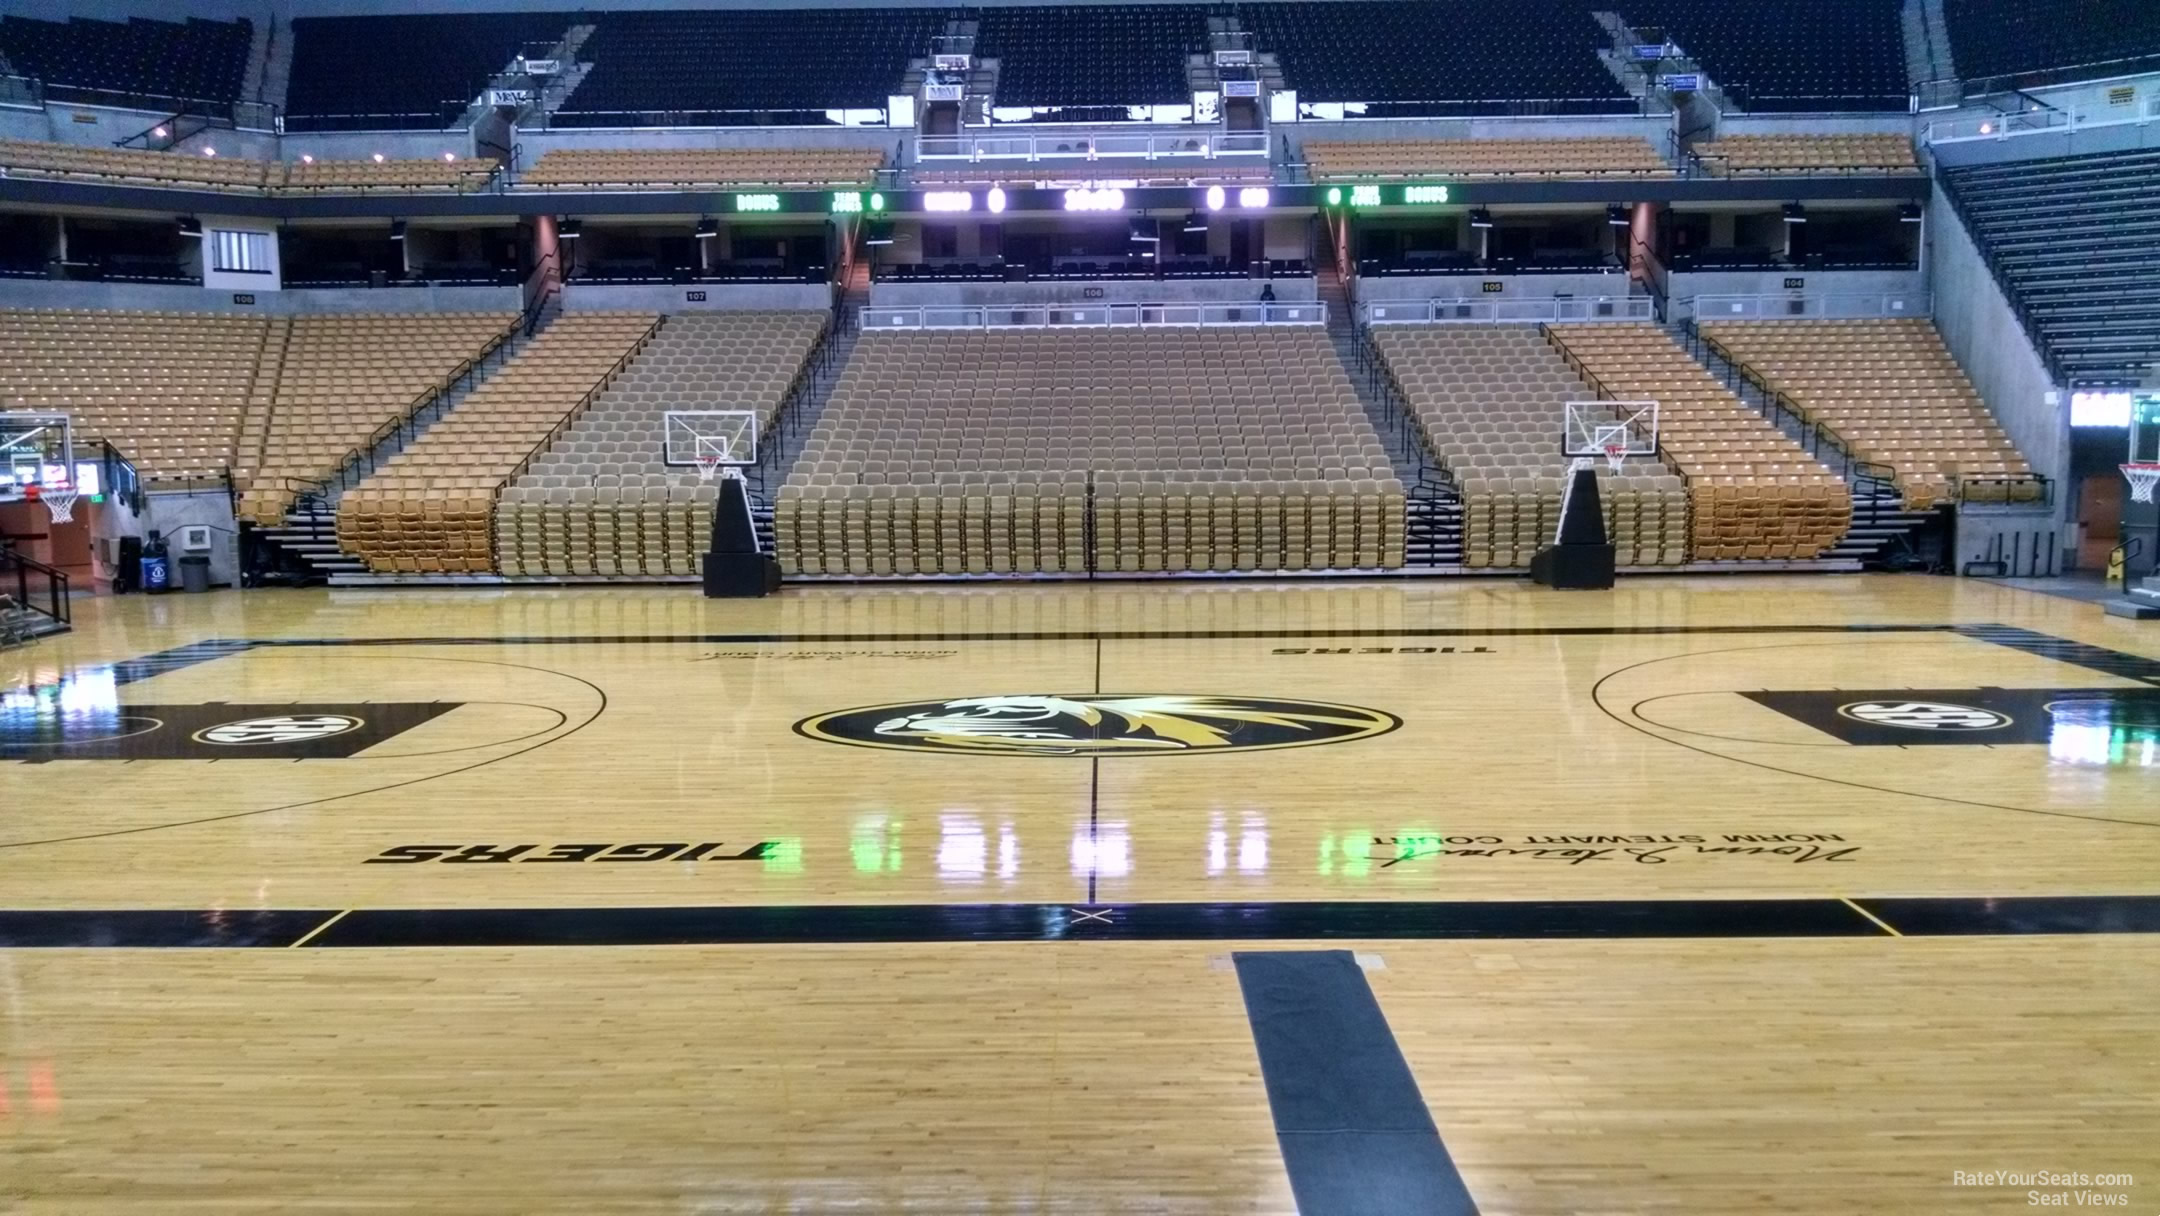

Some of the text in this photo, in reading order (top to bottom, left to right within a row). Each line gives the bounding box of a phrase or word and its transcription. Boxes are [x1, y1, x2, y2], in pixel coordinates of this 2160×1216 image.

[1404, 186, 1448, 204] BONUS
[1484, 283, 1501, 291] 105
[1785, 279, 1802, 288] 104
[688, 292, 705, 300] 107
[1085, 289, 1102, 297] 106
[1271, 647, 1497, 655] TIGERS
[1850, 703, 1999, 728] SEC
[205, 716, 352, 743] SEC
[1372, 834, 1846, 845] NORM STEWART COURT
[361, 842, 782, 865] TIGERS
